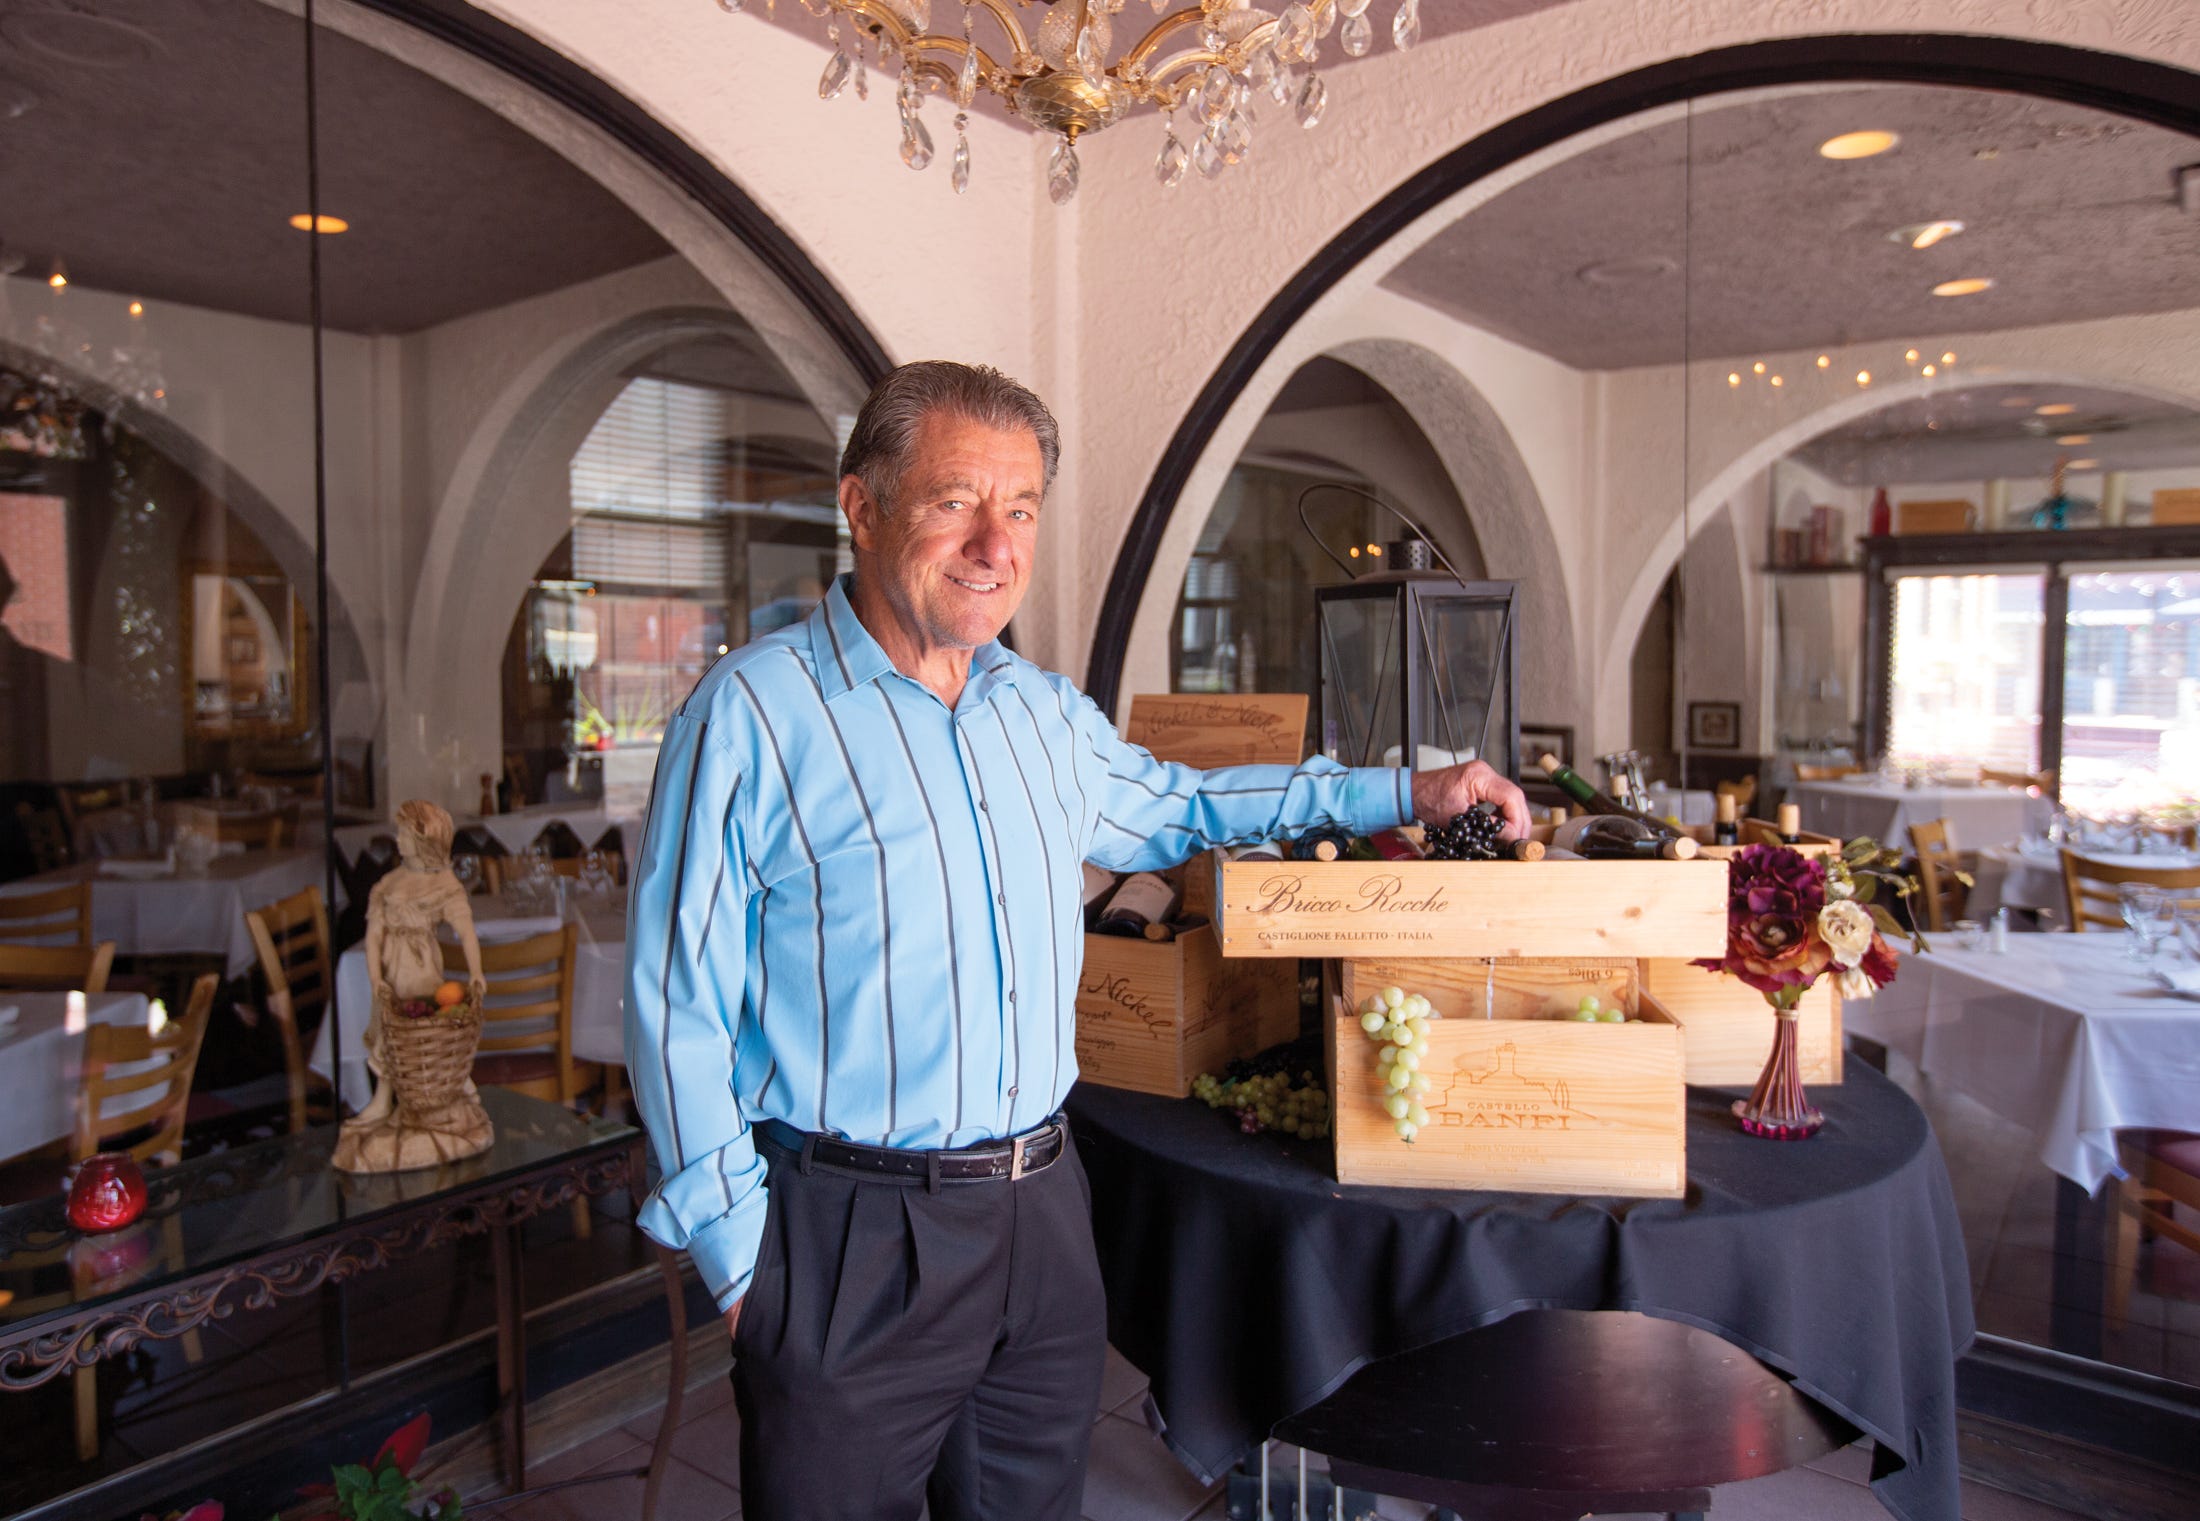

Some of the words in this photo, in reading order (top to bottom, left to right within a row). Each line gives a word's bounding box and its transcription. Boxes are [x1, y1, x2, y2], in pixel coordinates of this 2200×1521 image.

[1246, 874, 1342, 914] Bricco
[1346, 873, 1450, 914] Rocche
[1257, 931, 1332, 942] CASTIGLIONE
[1334, 931, 1389, 942] FALLETTO
[1397, 931, 1434, 942] ITALIA
[1087, 973, 1173, 1039] Nickel
[1466, 1101, 1541, 1112] CASTELLO
[1438, 1111, 1571, 1131] BANFI
